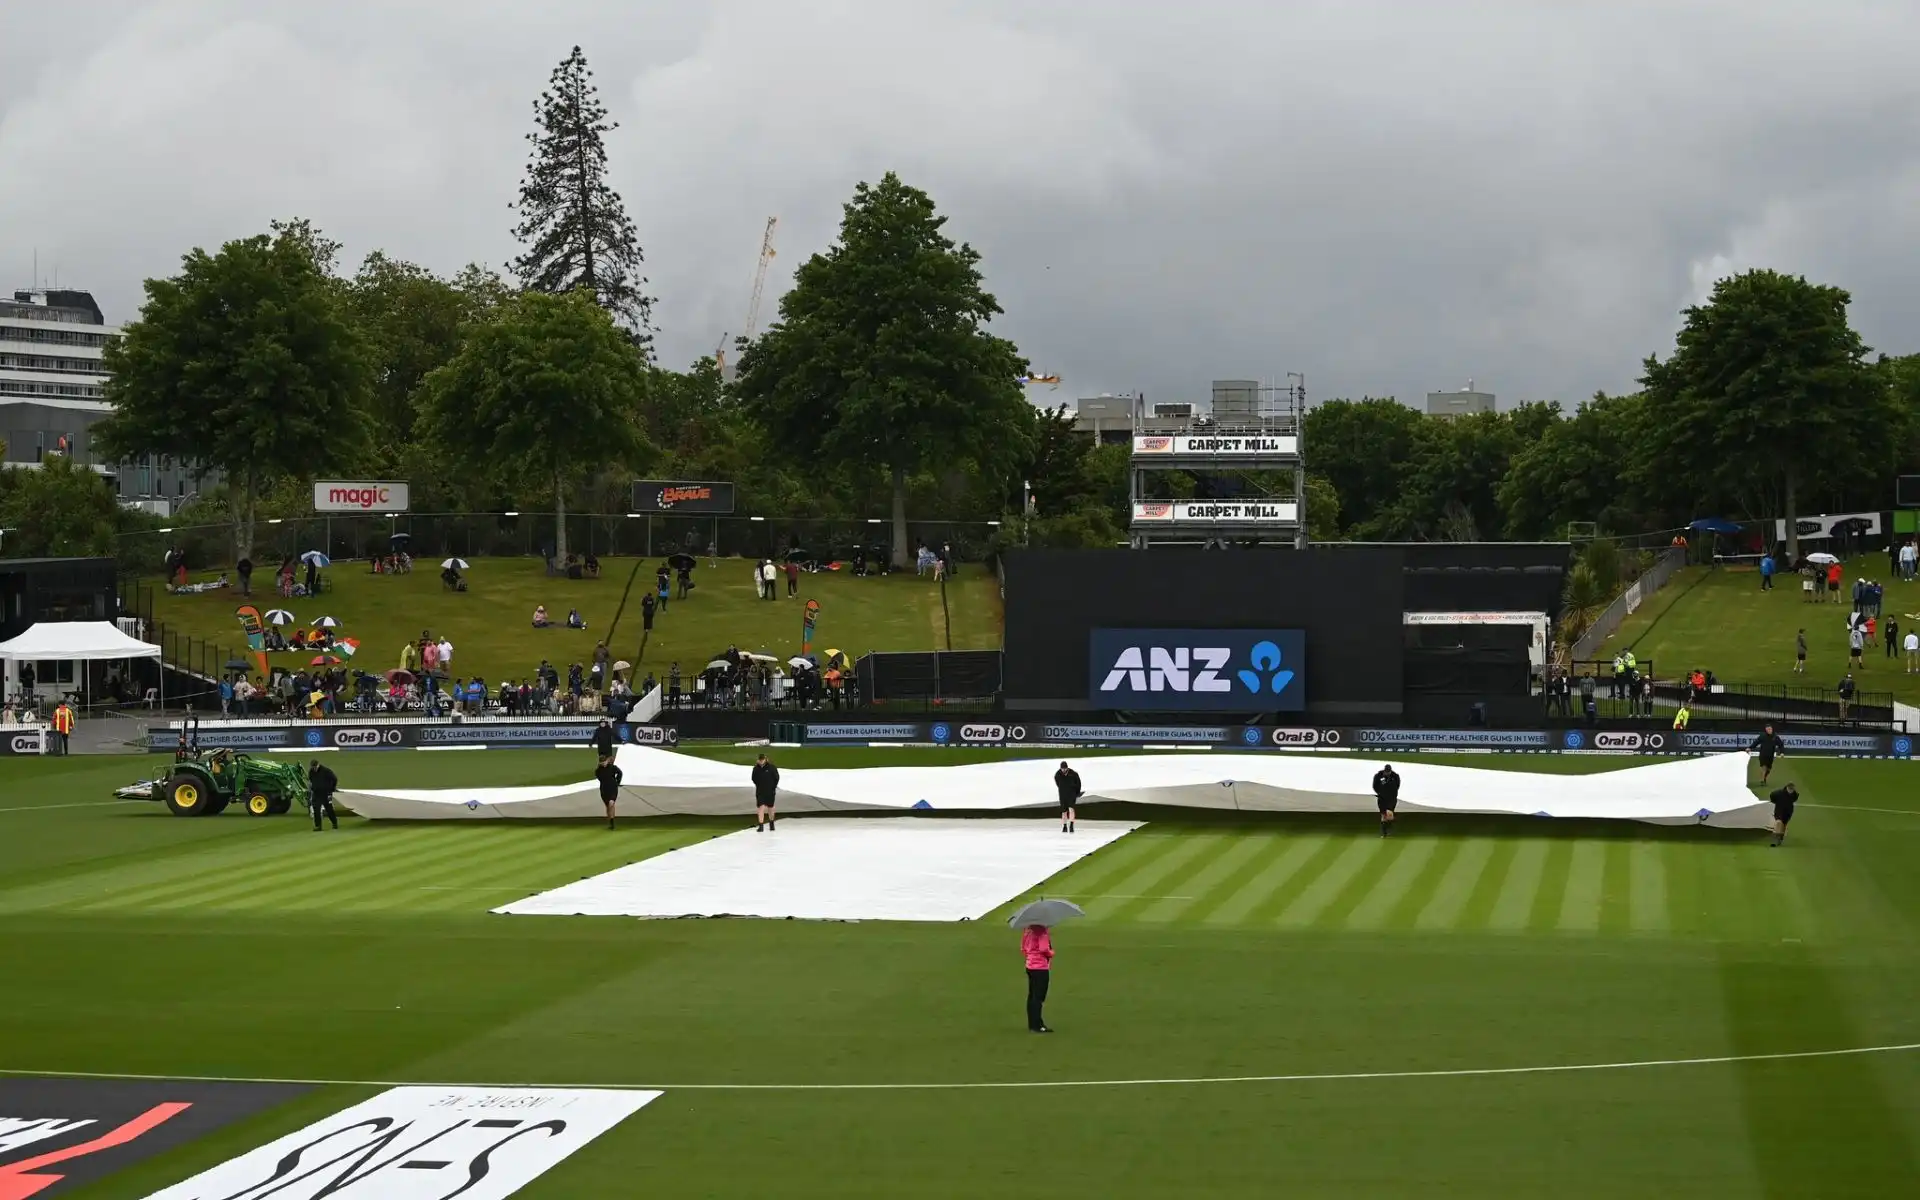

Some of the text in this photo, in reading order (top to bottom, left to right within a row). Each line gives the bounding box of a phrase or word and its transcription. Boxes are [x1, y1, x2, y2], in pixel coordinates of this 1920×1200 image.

[1188, 439, 1279, 451] CARPET MILL
[329, 485, 390, 508] magic
[1188, 506, 1279, 518] CARPET MILL
[1100, 647, 1231, 692] ANZ
[338, 732, 376, 743] Oral-B
[509, 730, 548, 738] HEALTHIER
[638, 729, 662, 740] Oral-B
[964, 727, 1001, 738] Oral-B
[1042, 727, 1070, 738] 100%
[1070, 729, 1103, 737] CLEANER
[1131, 730, 1169, 738] HEALTHIER
[1276, 731, 1314, 742] Oral-B
[1360, 731, 1386, 742] 00%
[1387, 733, 1420, 741] CLEANER
[1449, 734, 1489, 742] HEALTHIER
[1490, 735, 1512, 743] GUMS
[1514, 735, 1522, 743] IN
[194, 735, 230, 743] EALTHIER
[1599, 735, 1638, 746] Oral-B
[1681, 735, 1710, 745] 100%
[1711, 737, 1747, 745] CLEANER
[1818, 739, 1841, 747] GUMS
